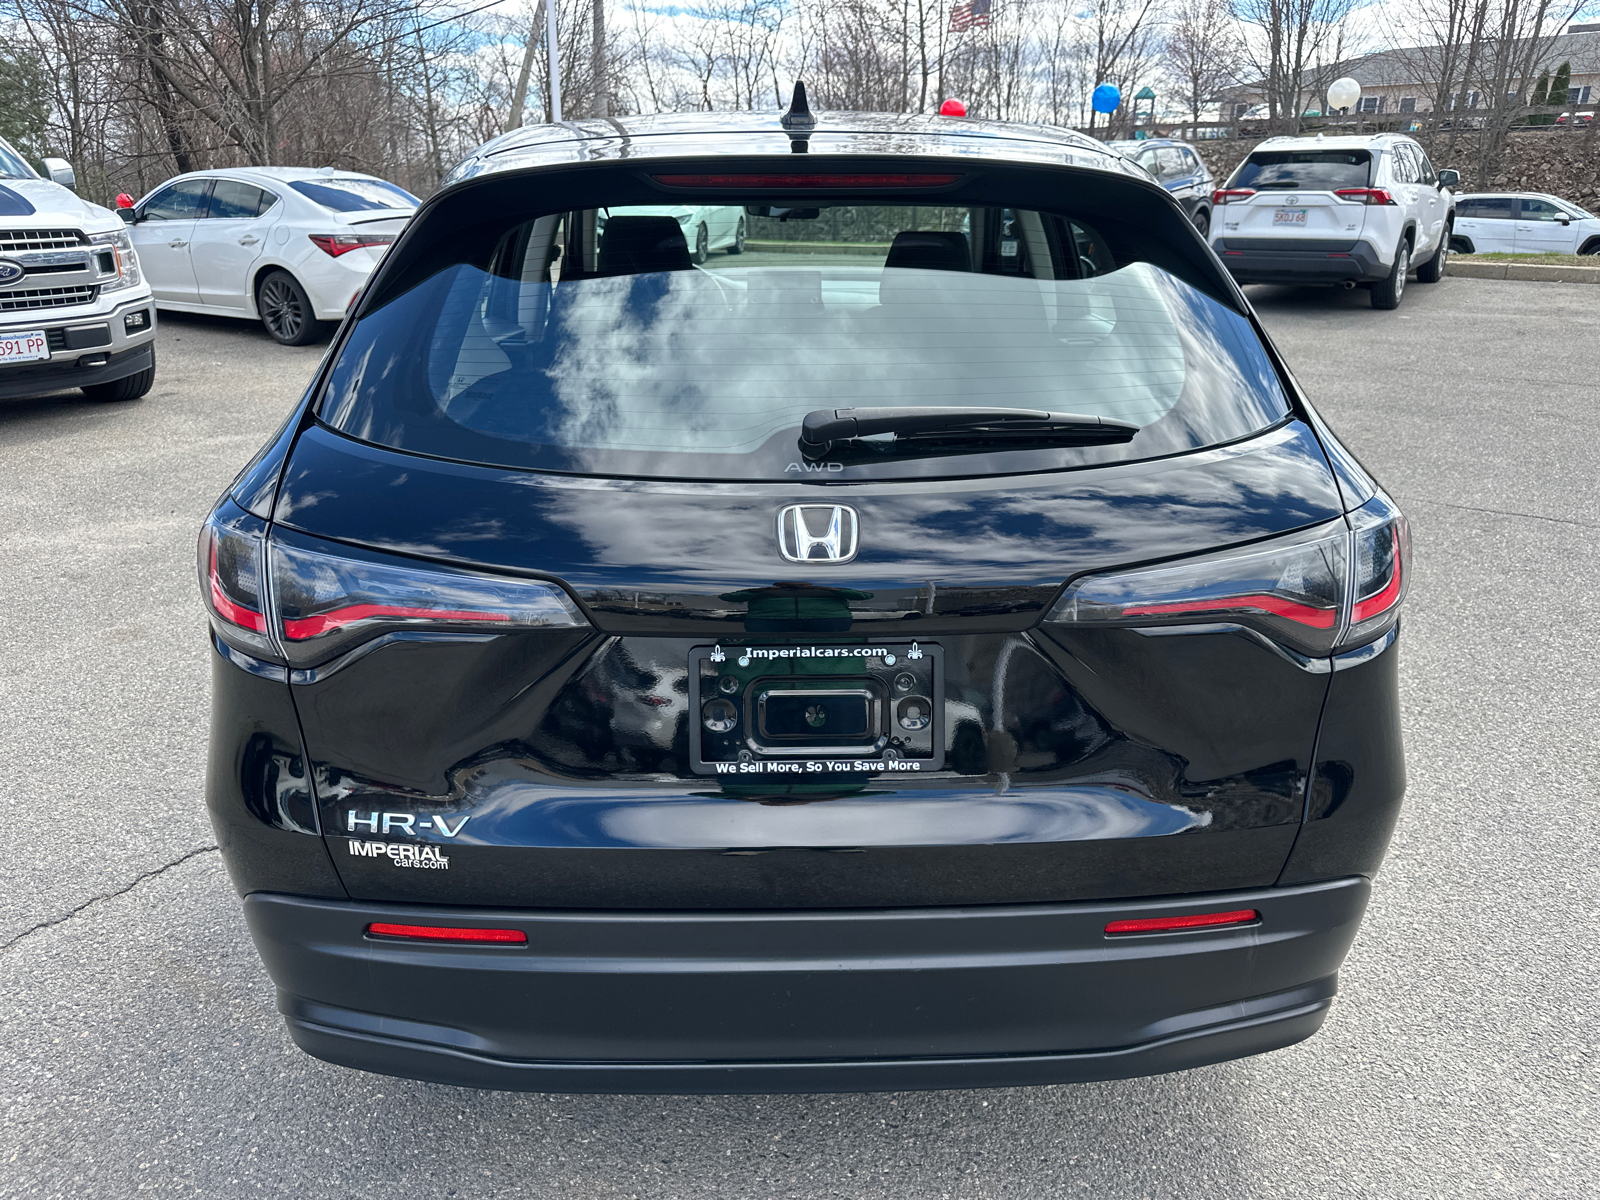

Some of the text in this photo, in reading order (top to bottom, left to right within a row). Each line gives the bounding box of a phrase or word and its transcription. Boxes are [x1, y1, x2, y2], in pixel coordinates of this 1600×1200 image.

[1295, 213, 1306, 222] 68
[26, 338, 44, 353] PP
[784, 462, 844, 473] AWD
[745, 646, 888, 660] Imperialcars.com
[716, 760, 921, 774] We Sell More, So You Save More
[347, 810, 472, 838] HR-V
[348, 839, 449, 862] IMPERIAL
[394, 858, 449, 870] cars.com
